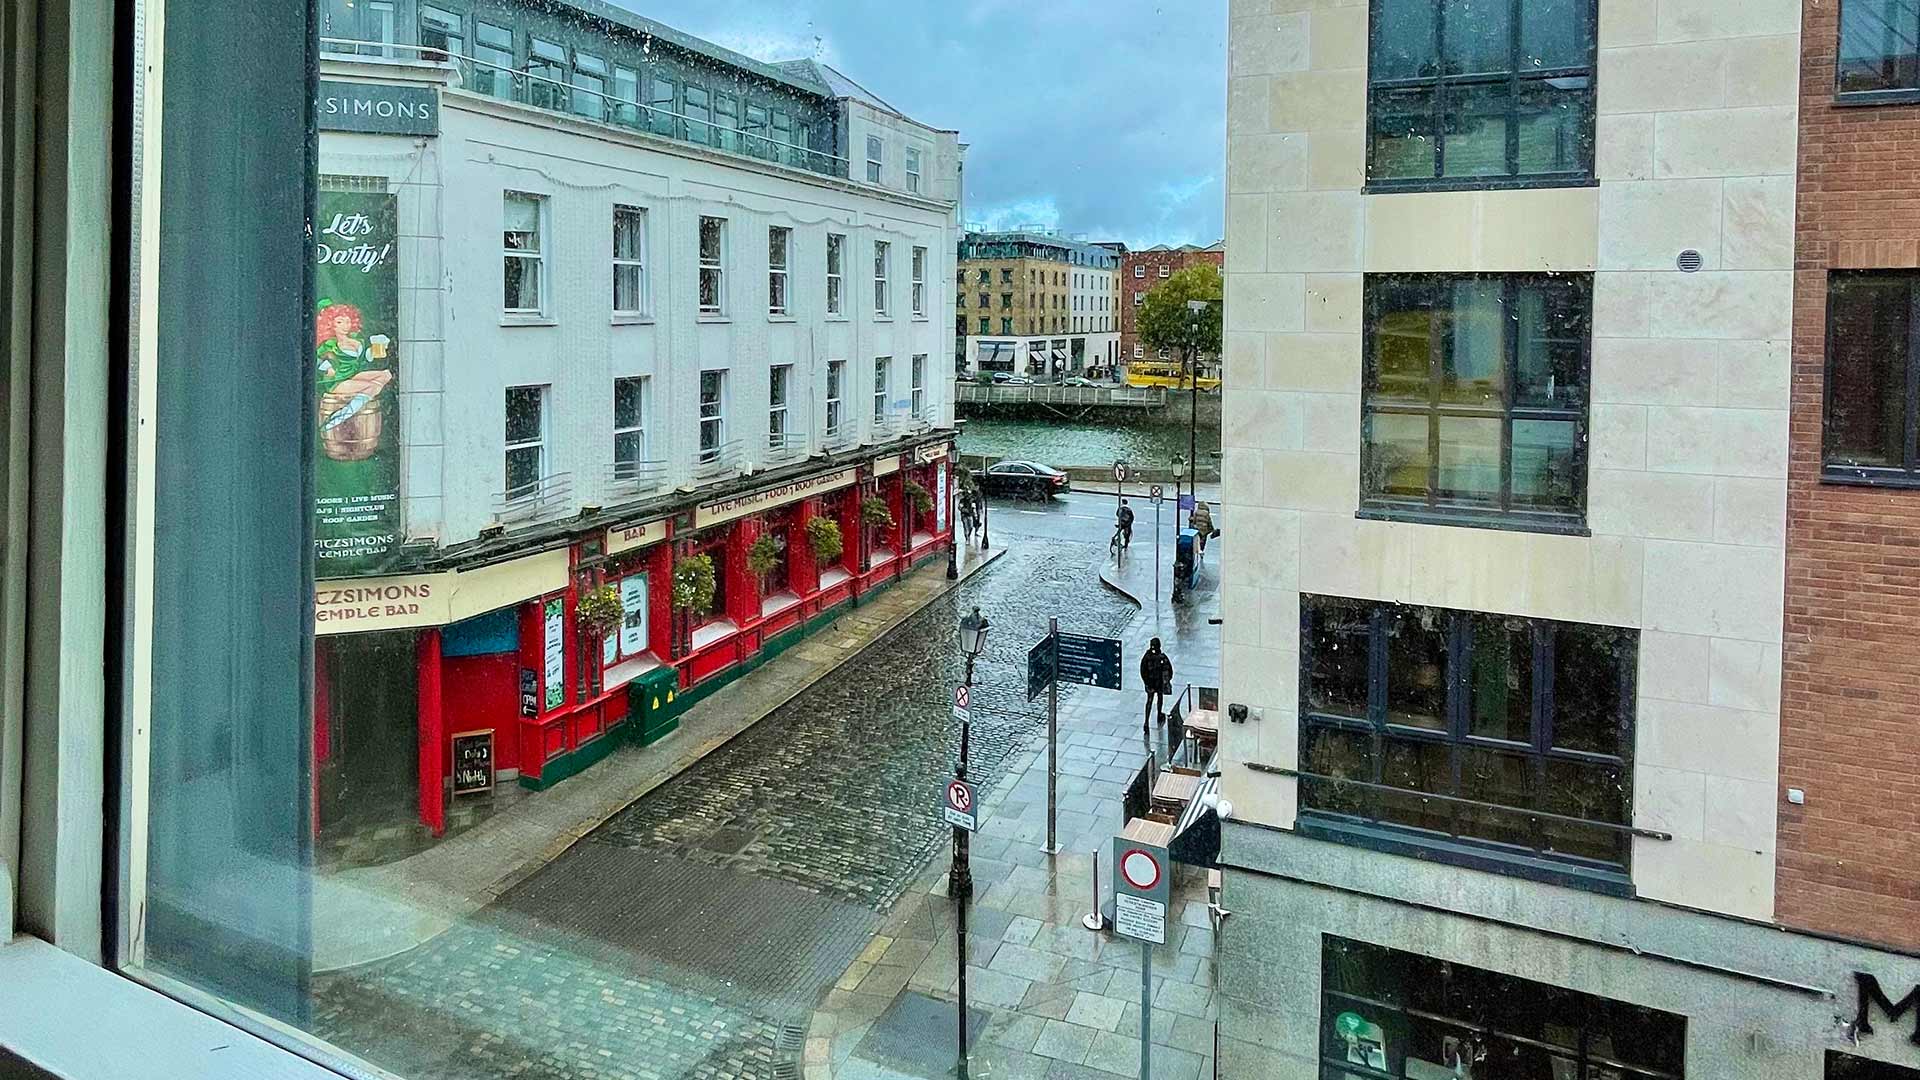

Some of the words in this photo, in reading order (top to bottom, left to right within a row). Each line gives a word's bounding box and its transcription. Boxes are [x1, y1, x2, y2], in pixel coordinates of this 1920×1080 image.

[319, 97, 430, 119] SIMONS
[322, 213, 373, 242] Let's
[351, 495, 369, 503] LIVE
[370, 493, 395, 501] MUSIC
[340, 504, 385, 513] NIGHTCLUB
[346, 514, 378, 523] GARDEN
[624, 526, 646, 541] BAR
[316, 584, 431, 605] TZSIMONS
[316, 606, 380, 622] EMPLE
[384, 603, 420, 617] BAR
